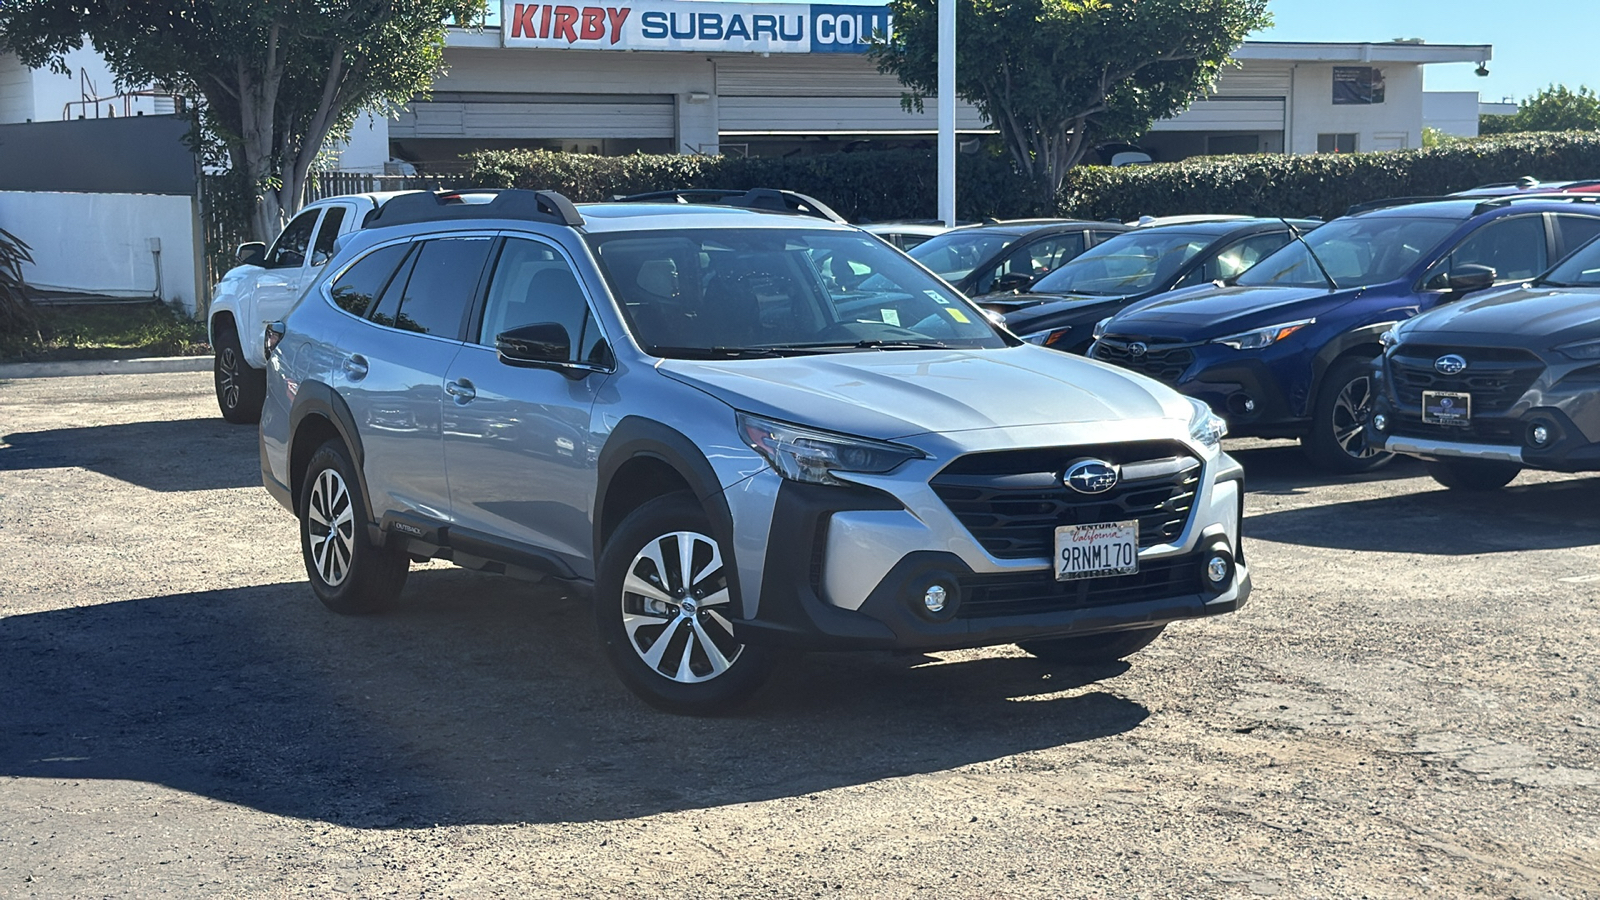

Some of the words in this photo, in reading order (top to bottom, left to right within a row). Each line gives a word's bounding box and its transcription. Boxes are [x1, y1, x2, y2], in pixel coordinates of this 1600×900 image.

[511, 3, 631, 45] KIRBY
[641, 11, 803, 42] SUBARU
[816, 13, 904, 45] COLLI
[395, 522, 421, 534] OUTBACK
[1072, 530, 1121, 544] California
[1061, 542, 1132, 572] 9RNM170
